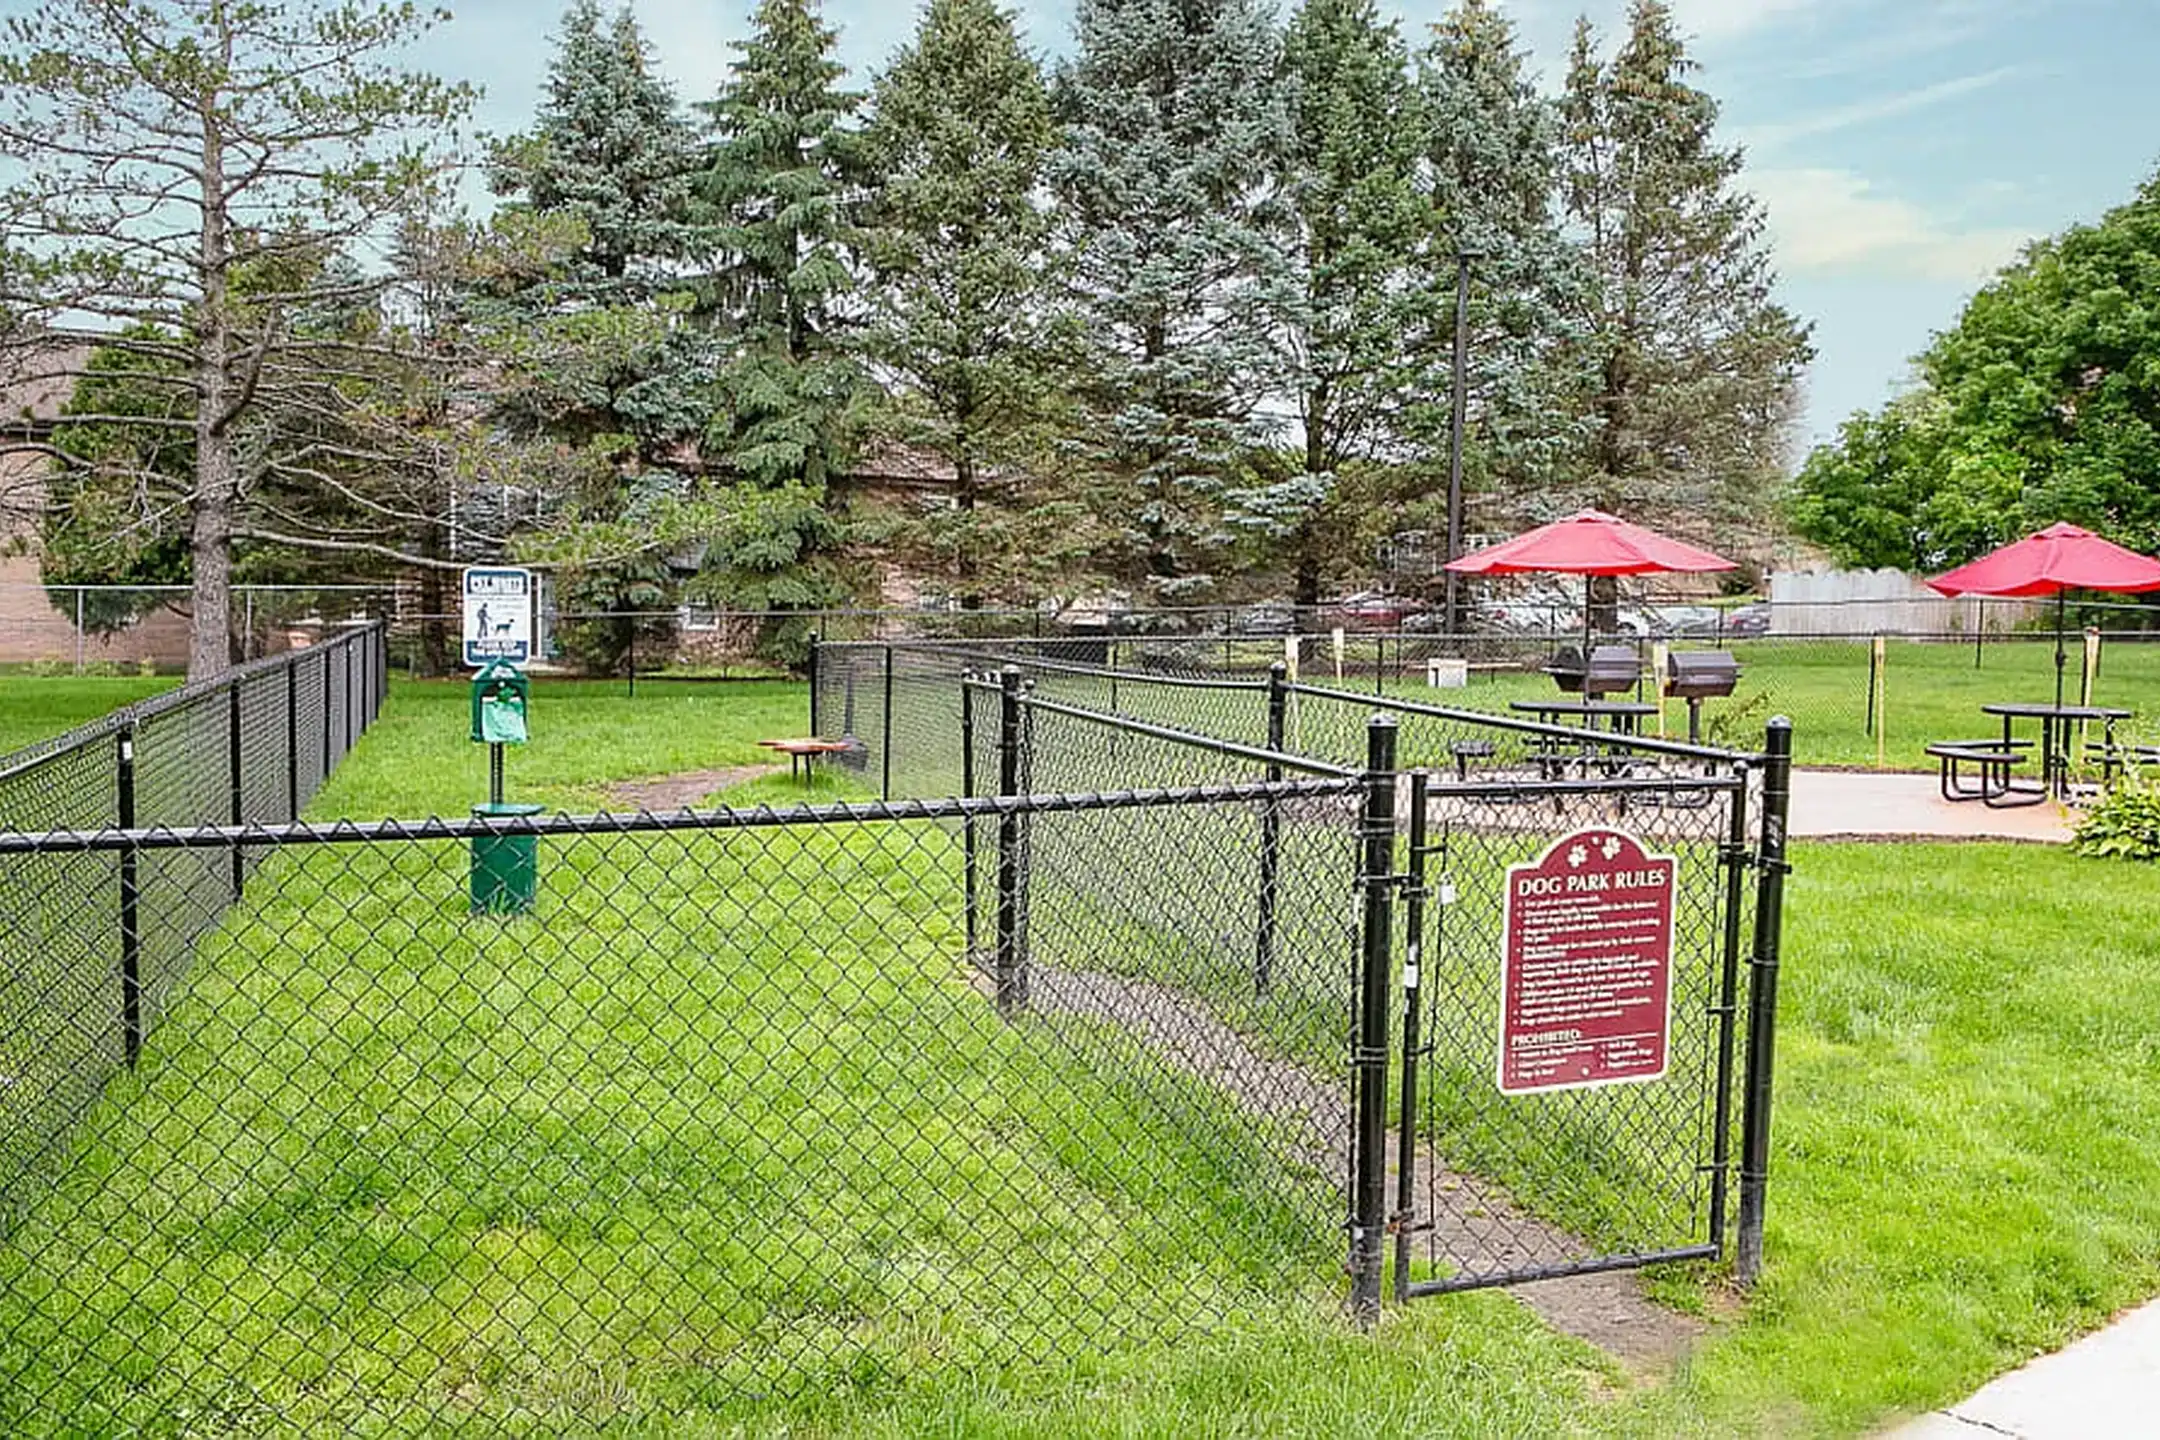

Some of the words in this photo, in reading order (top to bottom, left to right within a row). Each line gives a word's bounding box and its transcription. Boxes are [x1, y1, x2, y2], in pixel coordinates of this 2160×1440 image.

[1518, 877, 1562, 897] DOG
[1567, 873, 1612, 892] PARK
[1615, 868, 1667, 889] RULES
